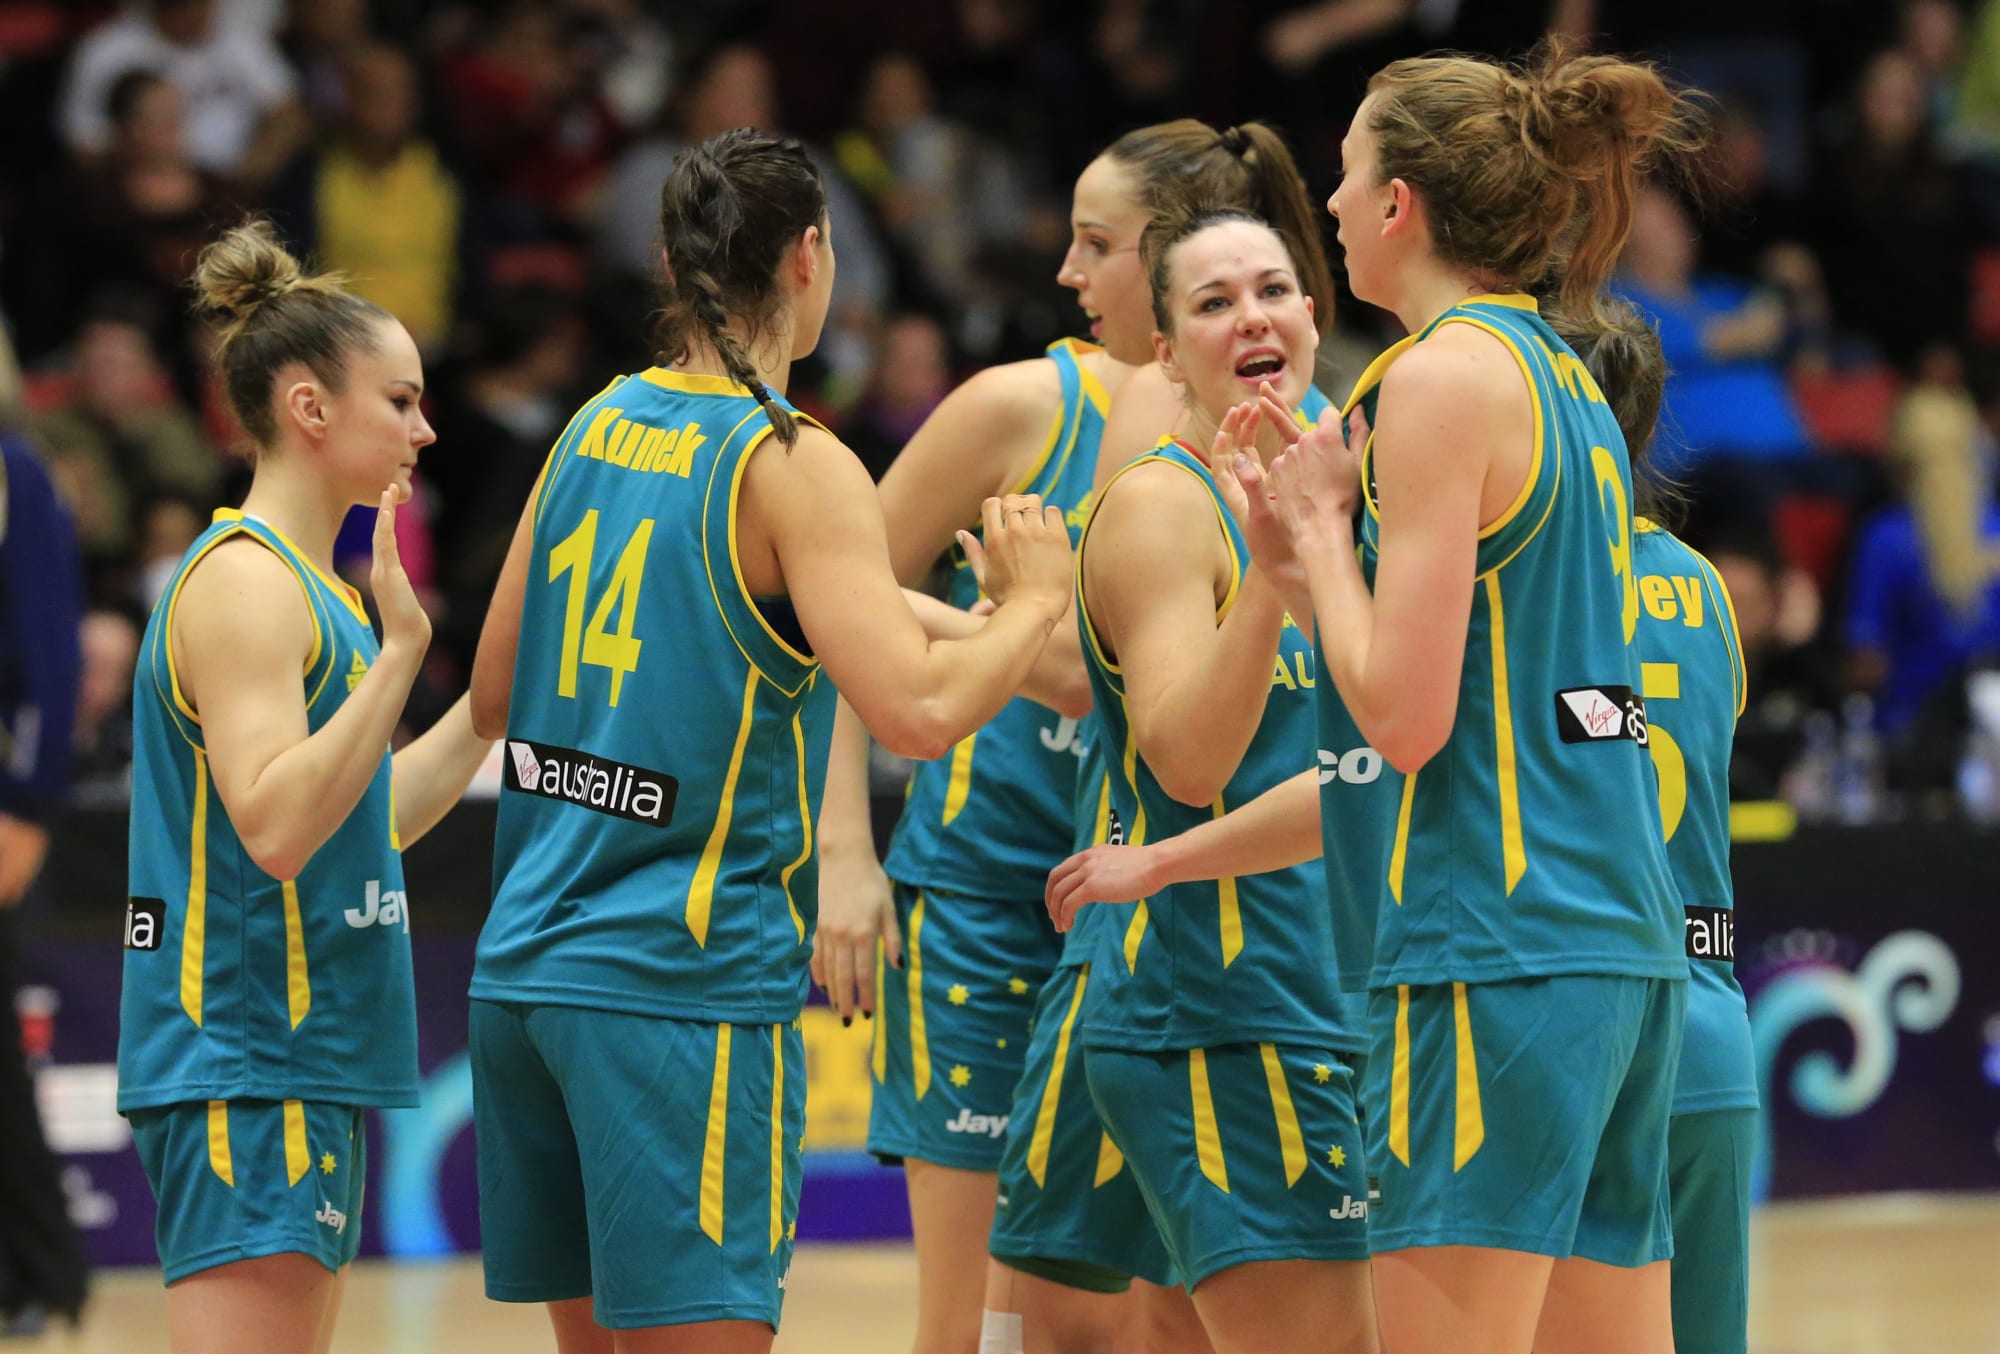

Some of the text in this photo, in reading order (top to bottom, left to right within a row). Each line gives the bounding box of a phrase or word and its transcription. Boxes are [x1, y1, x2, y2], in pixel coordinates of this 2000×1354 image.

[576, 407, 708, 479] Kunek
[548, 508, 655, 708] 14
[1632, 575, 1703, 628] ey
[1585, 699, 1618, 734] Virgin
[542, 759, 664, 820] australia
[946, 1108, 1010, 1138] Jay
